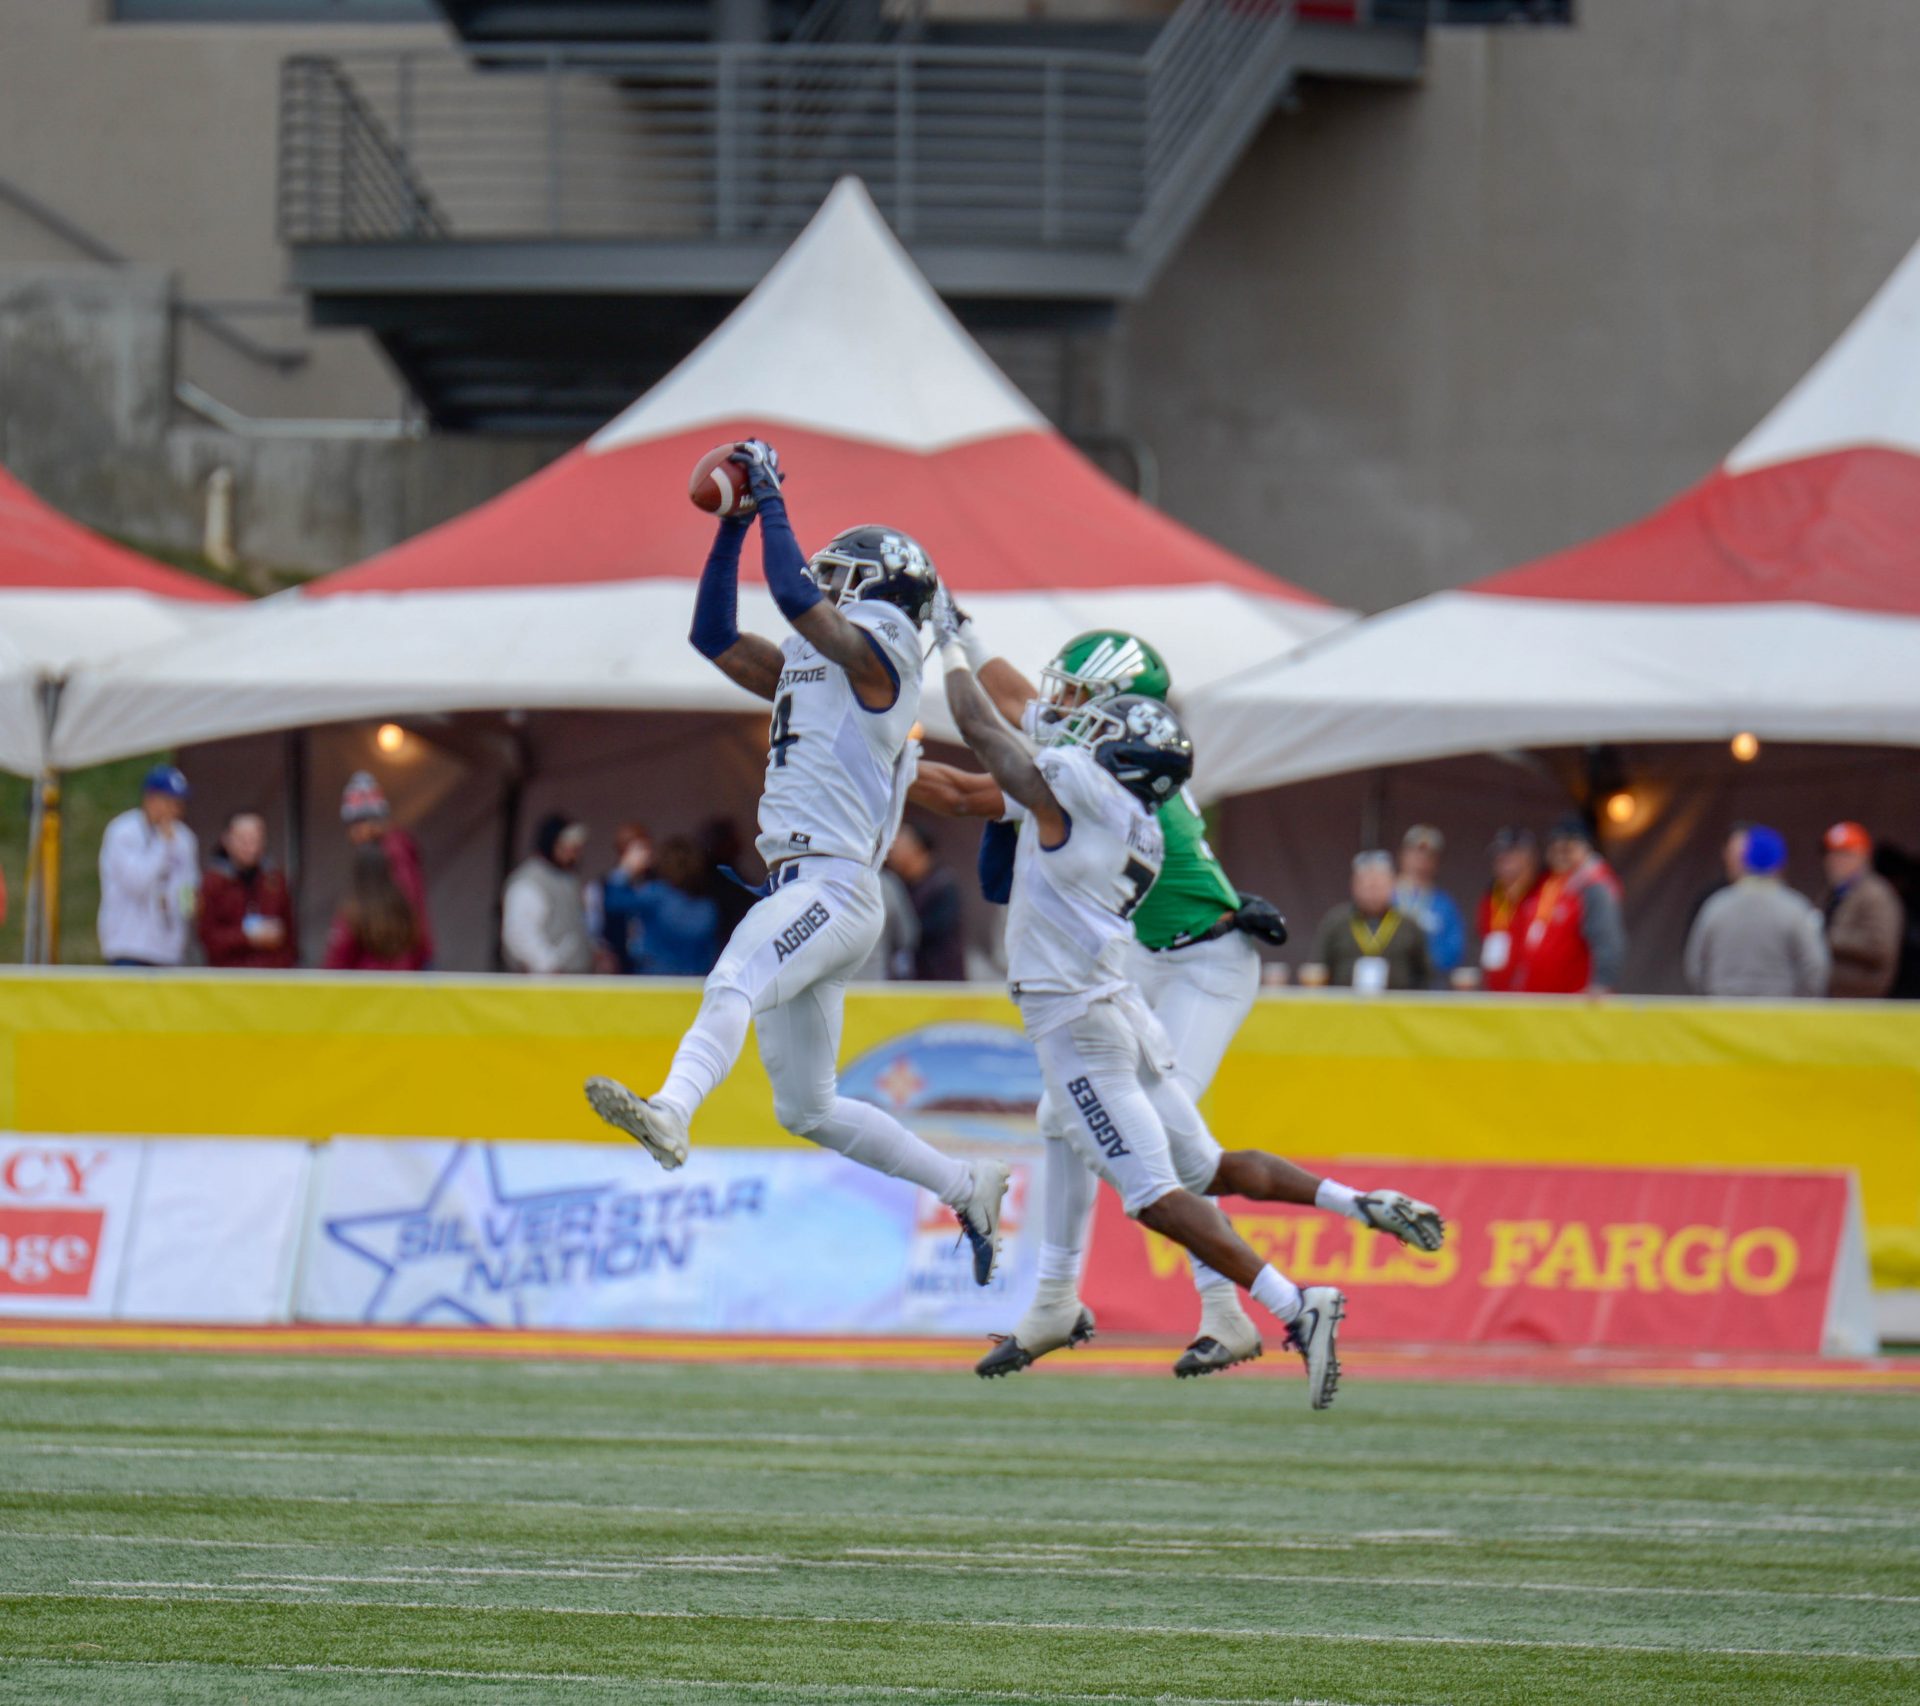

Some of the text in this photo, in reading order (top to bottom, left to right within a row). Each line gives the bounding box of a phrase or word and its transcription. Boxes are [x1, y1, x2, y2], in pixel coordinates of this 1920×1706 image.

[785, 666, 826, 685] STATE
[770, 694, 800, 767] 4
[773, 900, 830, 963] AGGIES
[1067, 1076, 1130, 1158] AGGIES
[608, 1178, 766, 1236] STAR
[463, 1235, 695, 1294] NATION
[1478, 1220, 1799, 1296] FARGO
